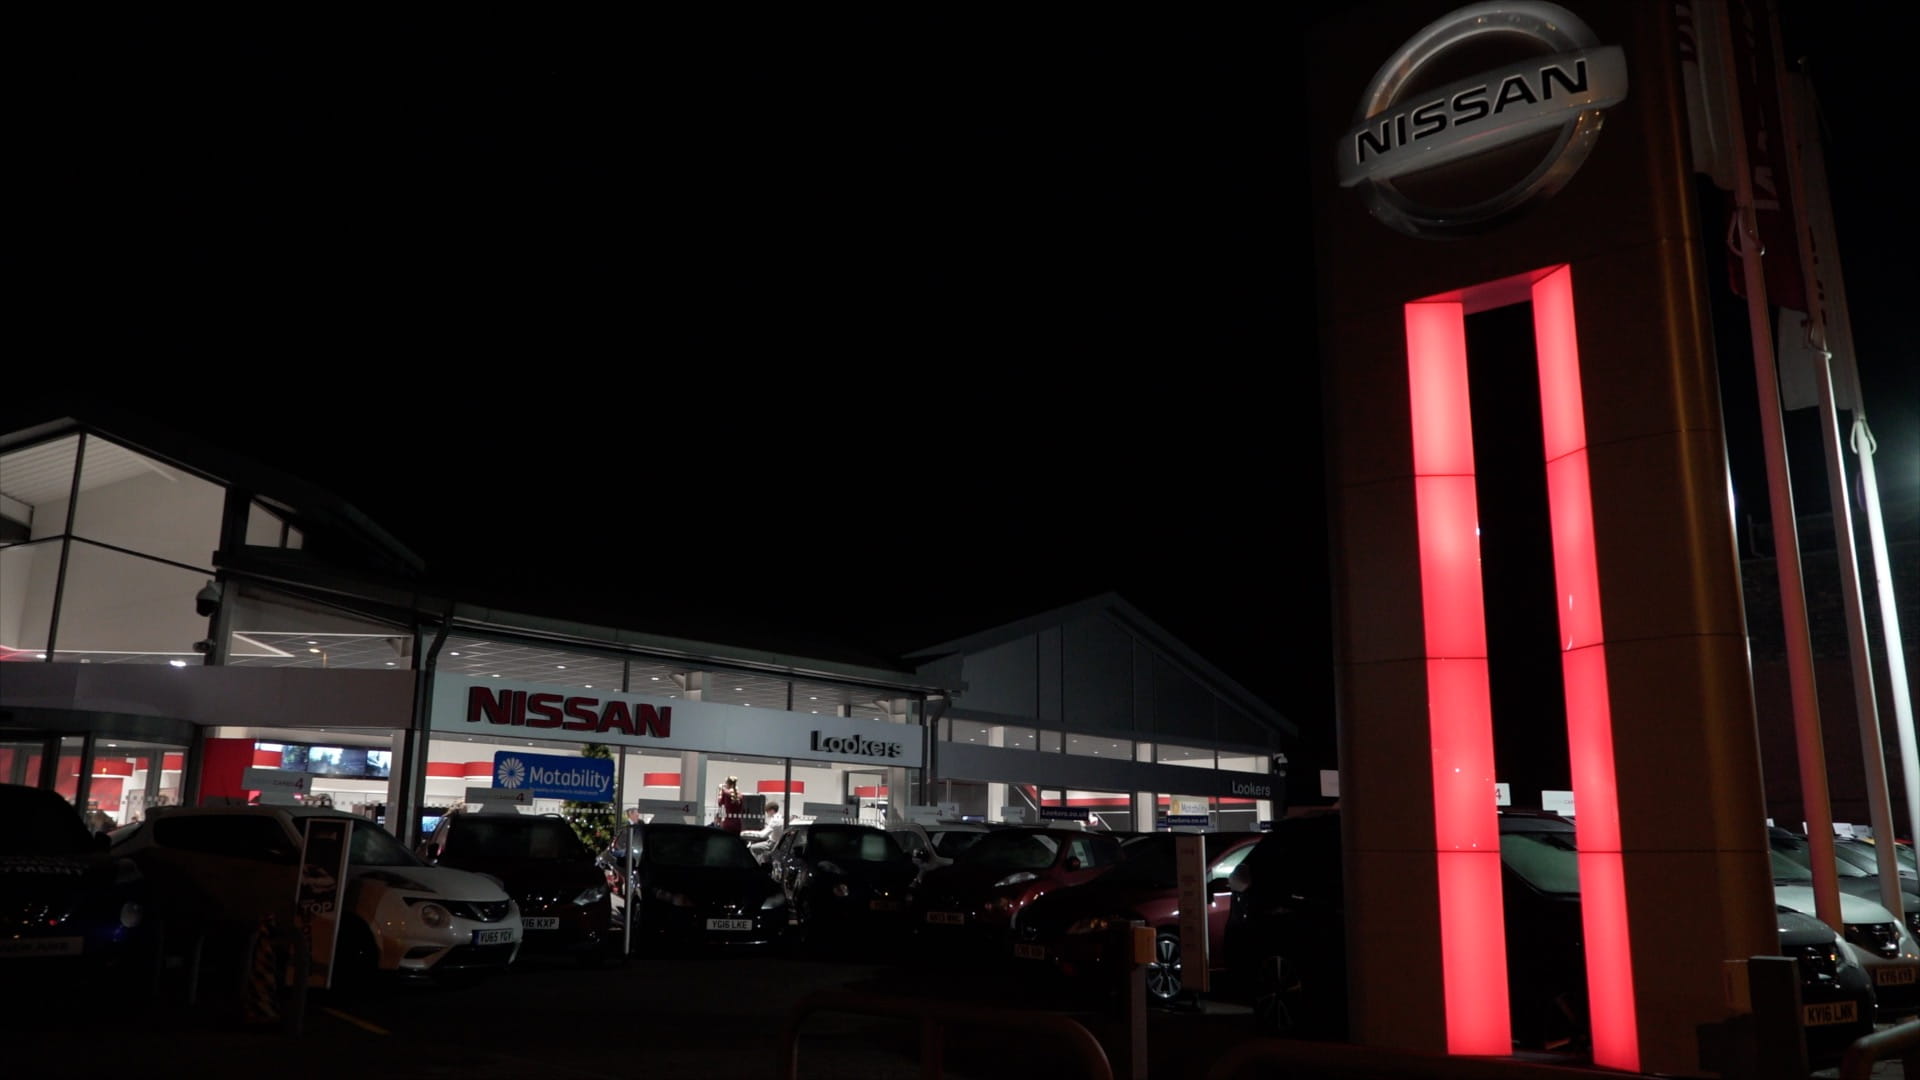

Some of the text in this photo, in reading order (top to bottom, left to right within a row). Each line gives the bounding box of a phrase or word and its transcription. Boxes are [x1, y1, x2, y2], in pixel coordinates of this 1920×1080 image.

[1355, 58, 1588, 165] NISSAN
[467, 686, 672, 738] NISSAN
[810, 730, 903, 758] Lookers
[529, 765, 610, 793] Motability
[1231, 779, 1271, 798] Lookers
[537, 918, 556, 928] KXP
